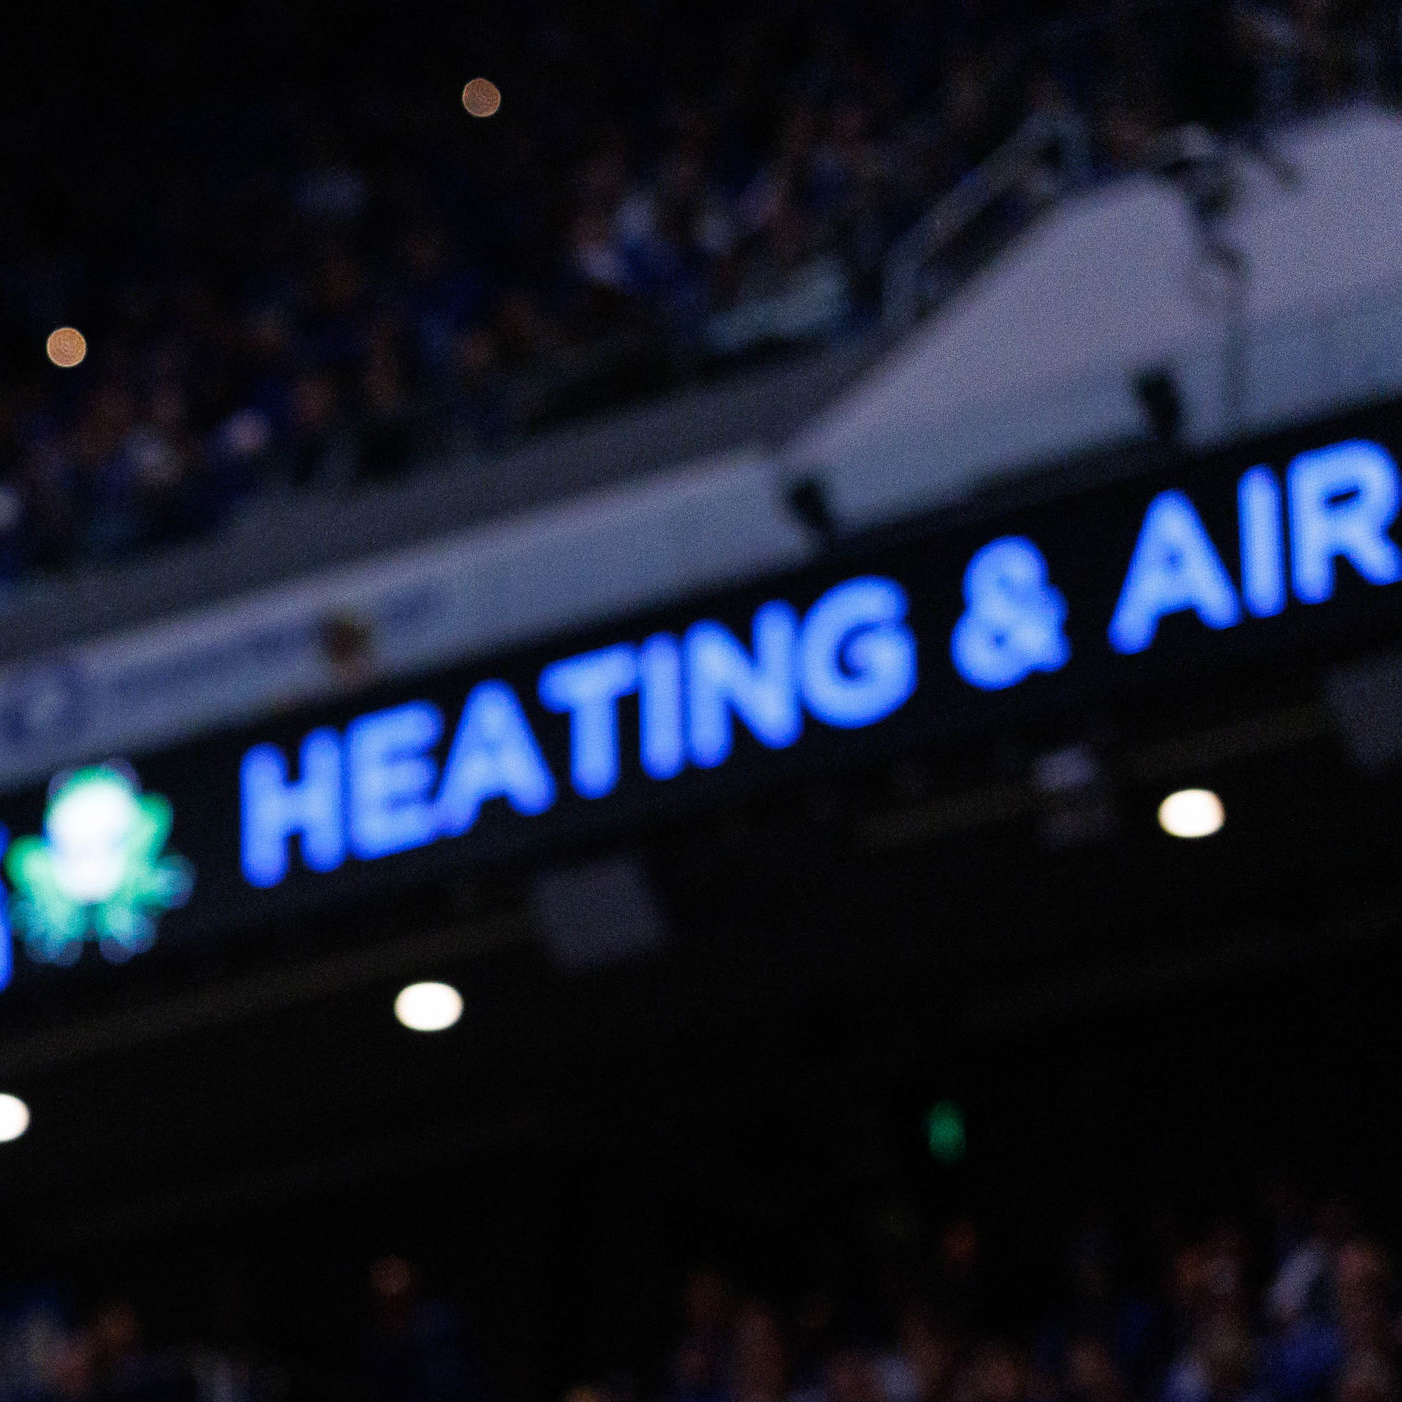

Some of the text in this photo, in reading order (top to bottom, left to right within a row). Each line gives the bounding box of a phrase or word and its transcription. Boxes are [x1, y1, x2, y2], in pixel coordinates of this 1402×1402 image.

[238, 574, 918, 888] HEATING
[951, 535, 1070, 690] &
[1107, 438, 1402, 653] AIR
